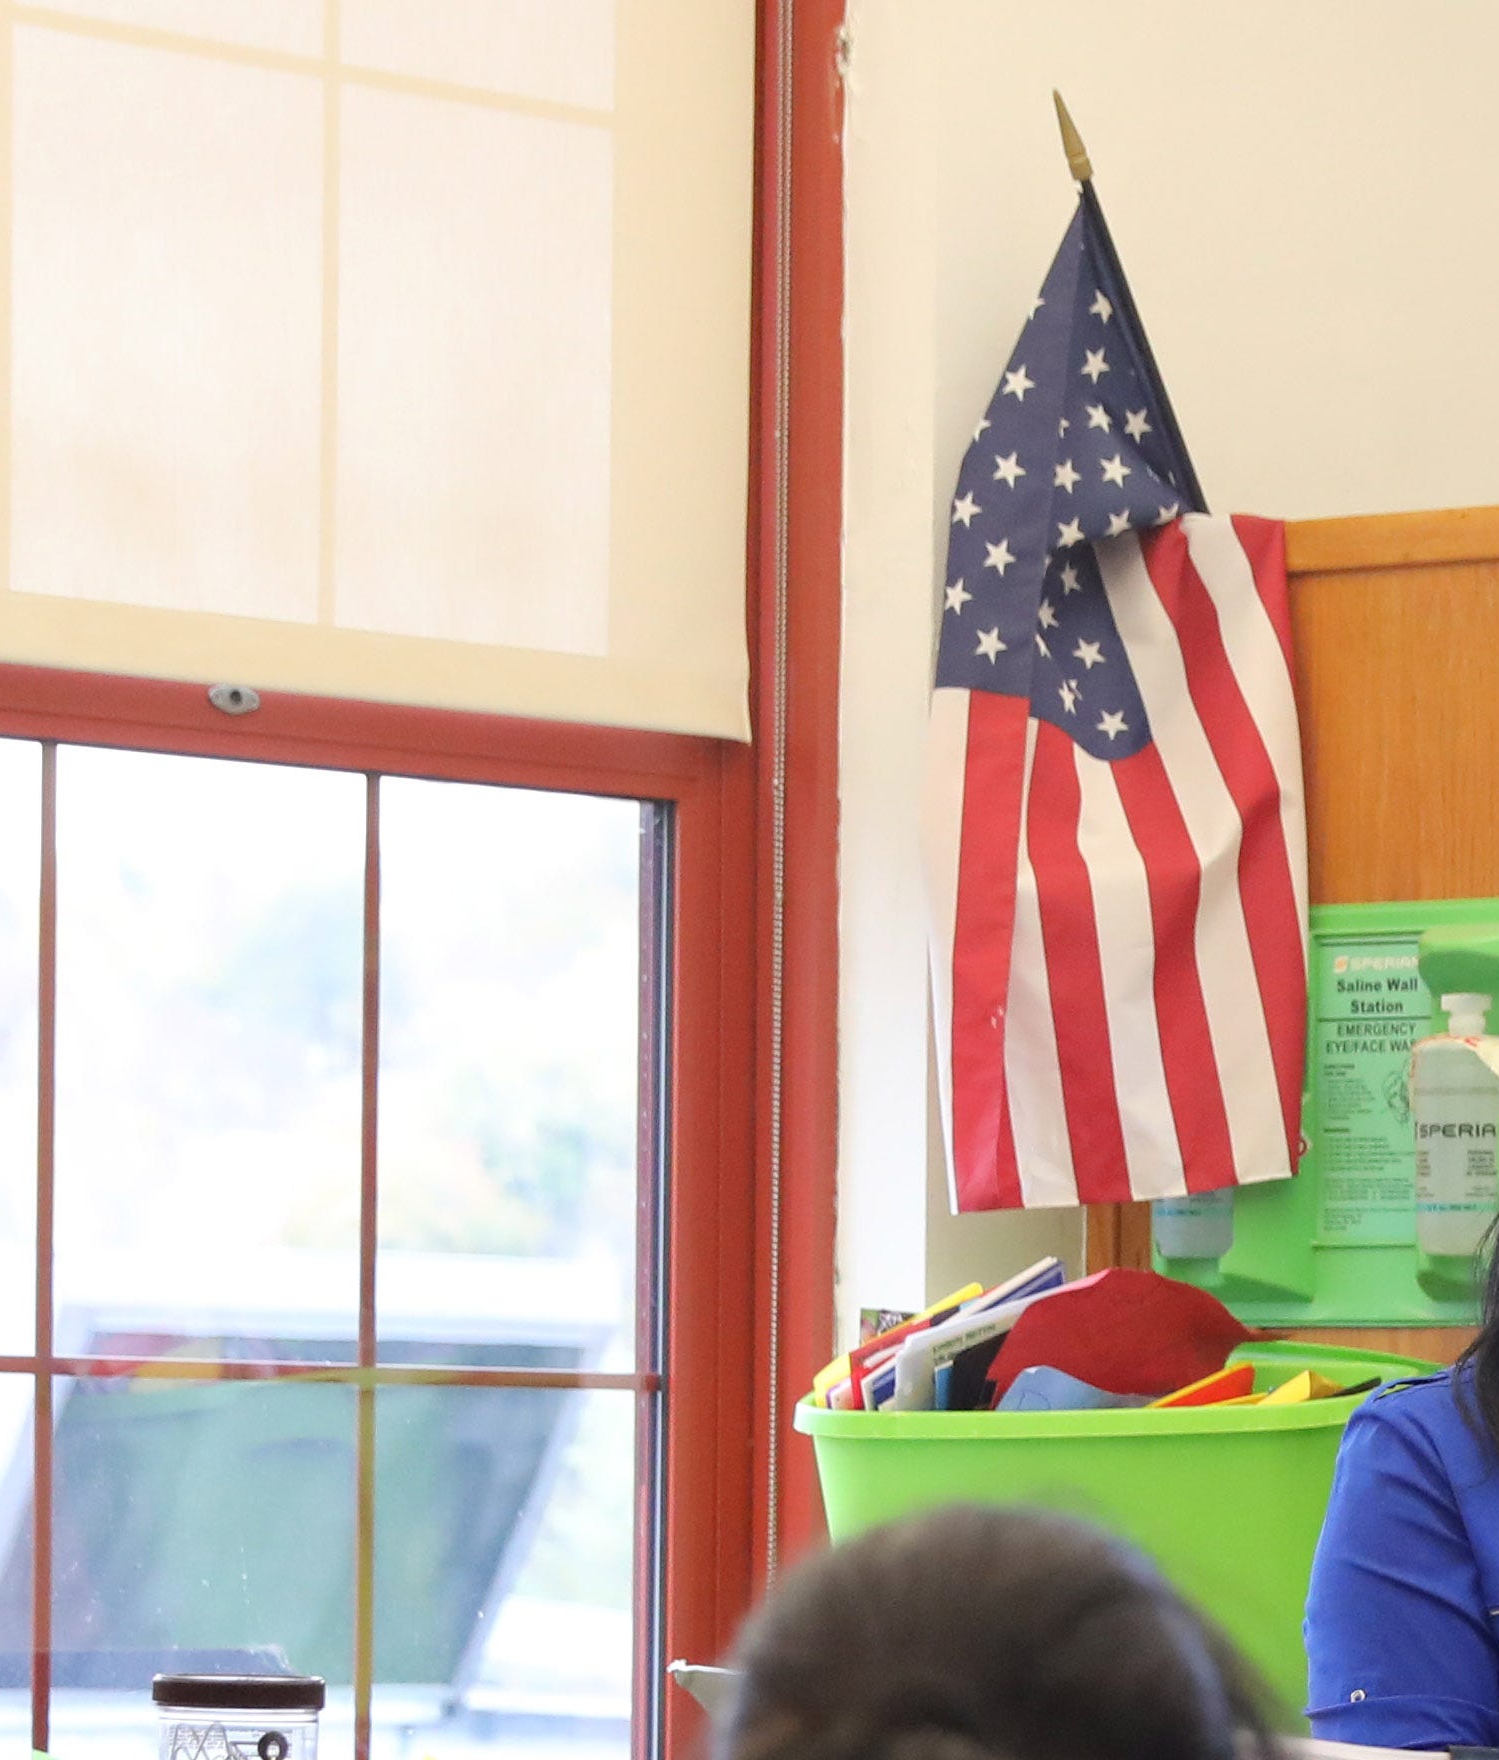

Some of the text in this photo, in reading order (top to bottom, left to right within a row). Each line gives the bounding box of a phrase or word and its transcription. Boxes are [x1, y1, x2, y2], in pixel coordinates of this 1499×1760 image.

[1337, 977, 1418, 993] Saline Wall
[1351, 998, 1403, 1013] Station
[1337, 1022, 1417, 1037] EMERGENCY
